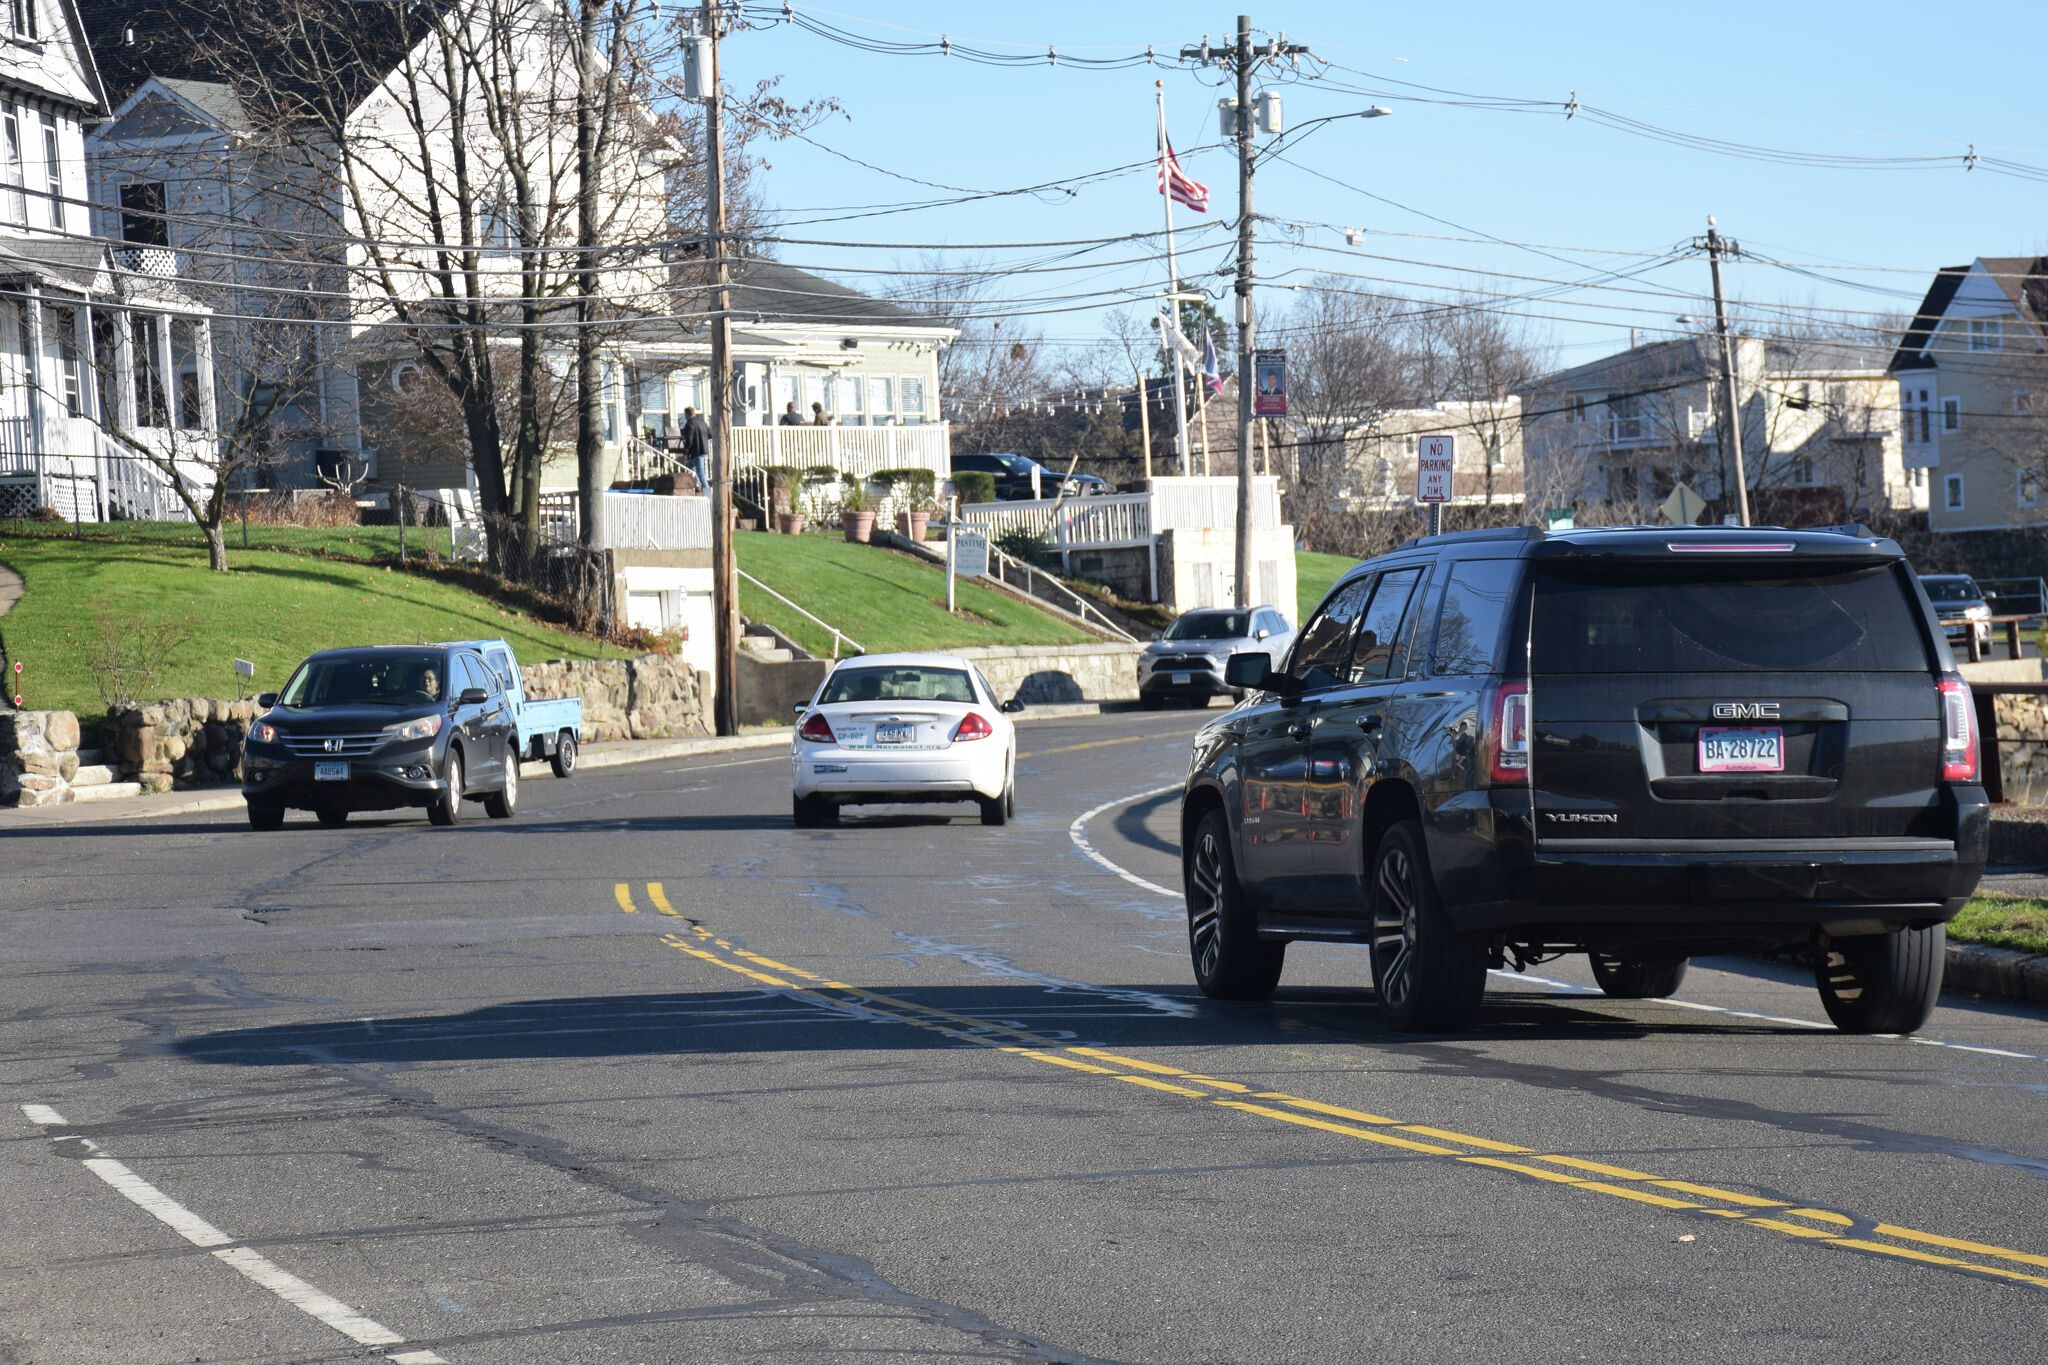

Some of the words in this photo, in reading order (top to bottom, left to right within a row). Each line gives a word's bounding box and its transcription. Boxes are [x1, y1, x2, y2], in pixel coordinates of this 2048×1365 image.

[1430, 443, 1443, 456] NO
[1420, 459, 1451, 472] PARKING
[1428, 474, 1442, 484] ANY
[1426, 486, 1443, 495] TIME
[956, 538, 985, 550] PASTIME
[1712, 703, 1780, 719] GMC
[1545, 813, 1618, 823] YUKON
